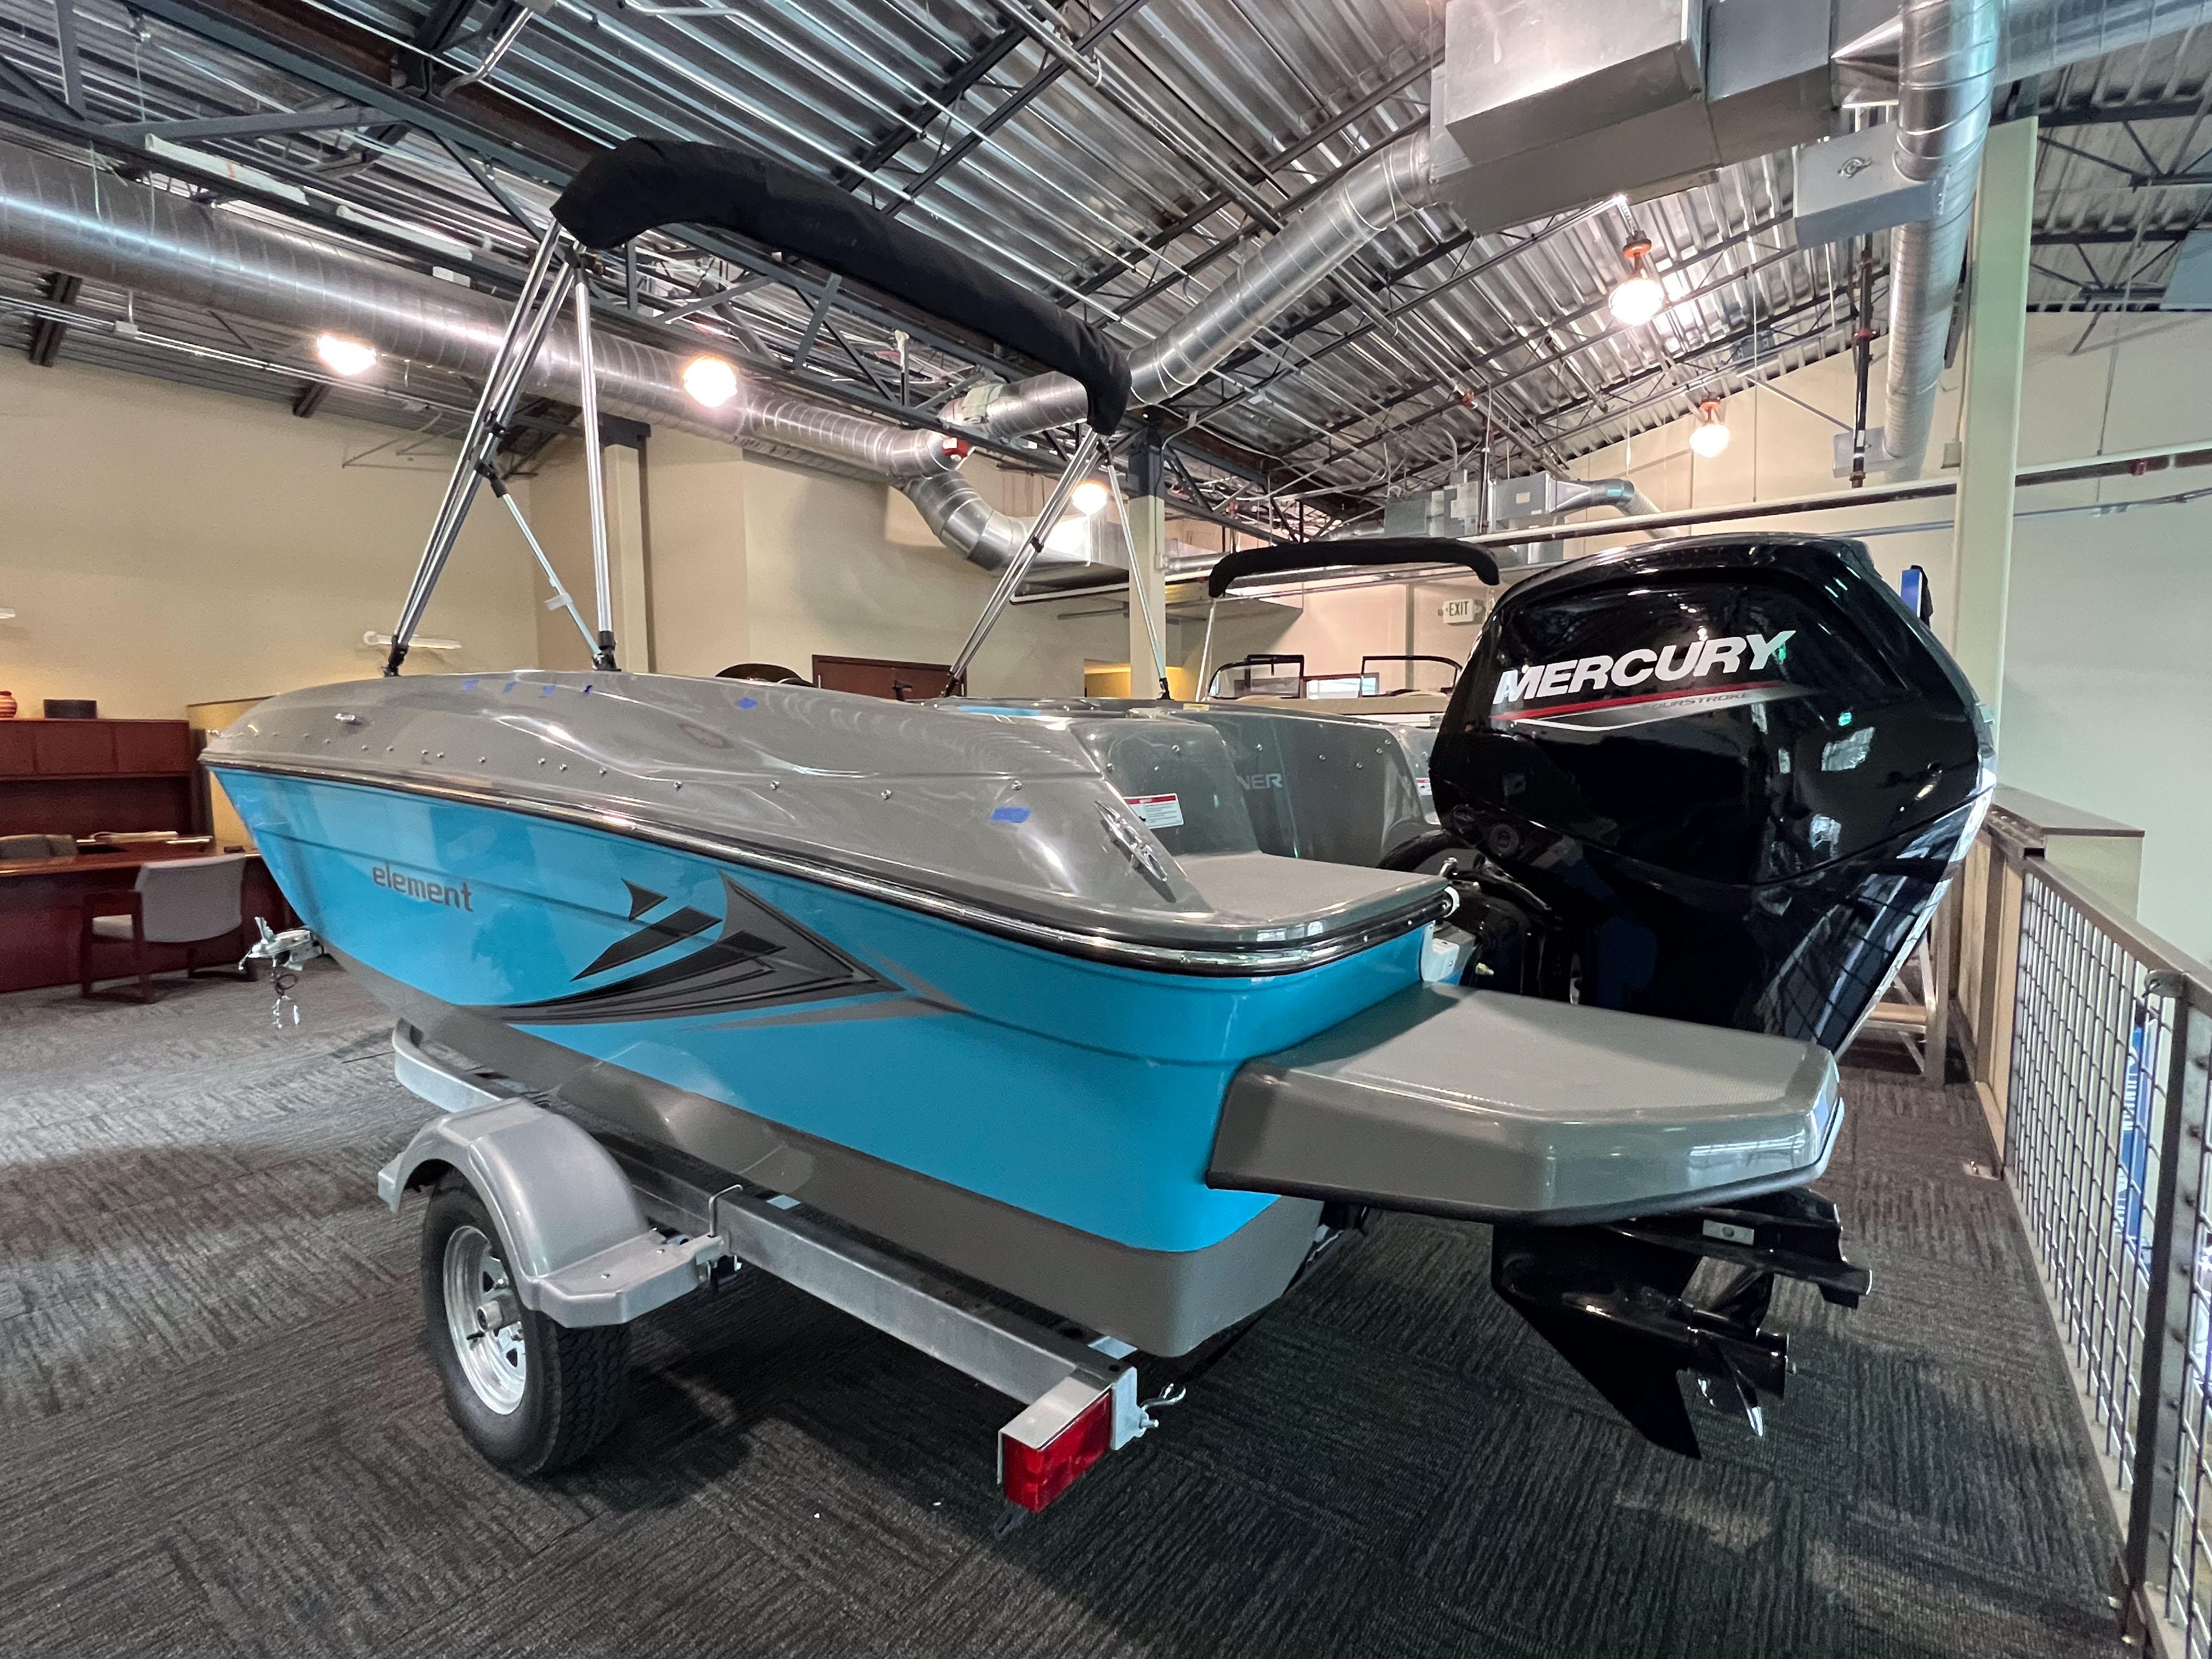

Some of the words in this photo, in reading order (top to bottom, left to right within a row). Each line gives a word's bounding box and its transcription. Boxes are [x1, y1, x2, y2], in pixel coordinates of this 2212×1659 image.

[1449, 601, 1469, 616] EXIT
[1492, 630, 1796, 704] MERCURY
[372, 862, 473, 912] element
